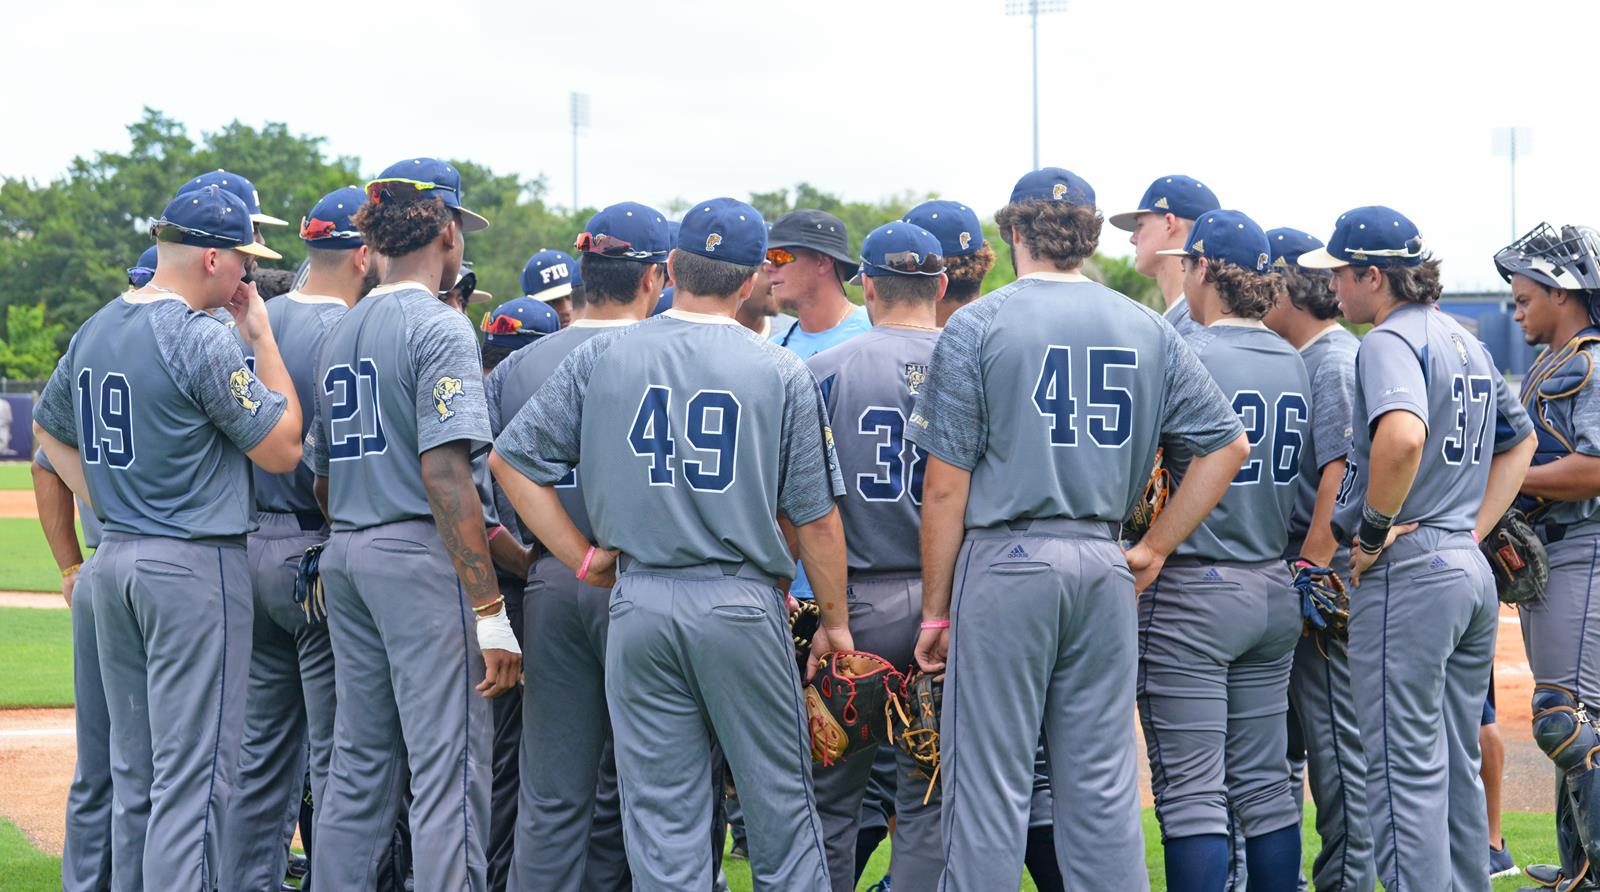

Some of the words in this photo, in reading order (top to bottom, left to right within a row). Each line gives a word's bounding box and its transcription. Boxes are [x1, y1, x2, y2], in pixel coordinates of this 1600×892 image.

[540, 263, 569, 285] FIU
[78, 367, 136, 470] 19
[626, 384, 742, 494] 49
[1031, 344, 1138, 448] 45
[1230, 389, 1309, 486] 26
[1441, 373, 1493, 466] 37
